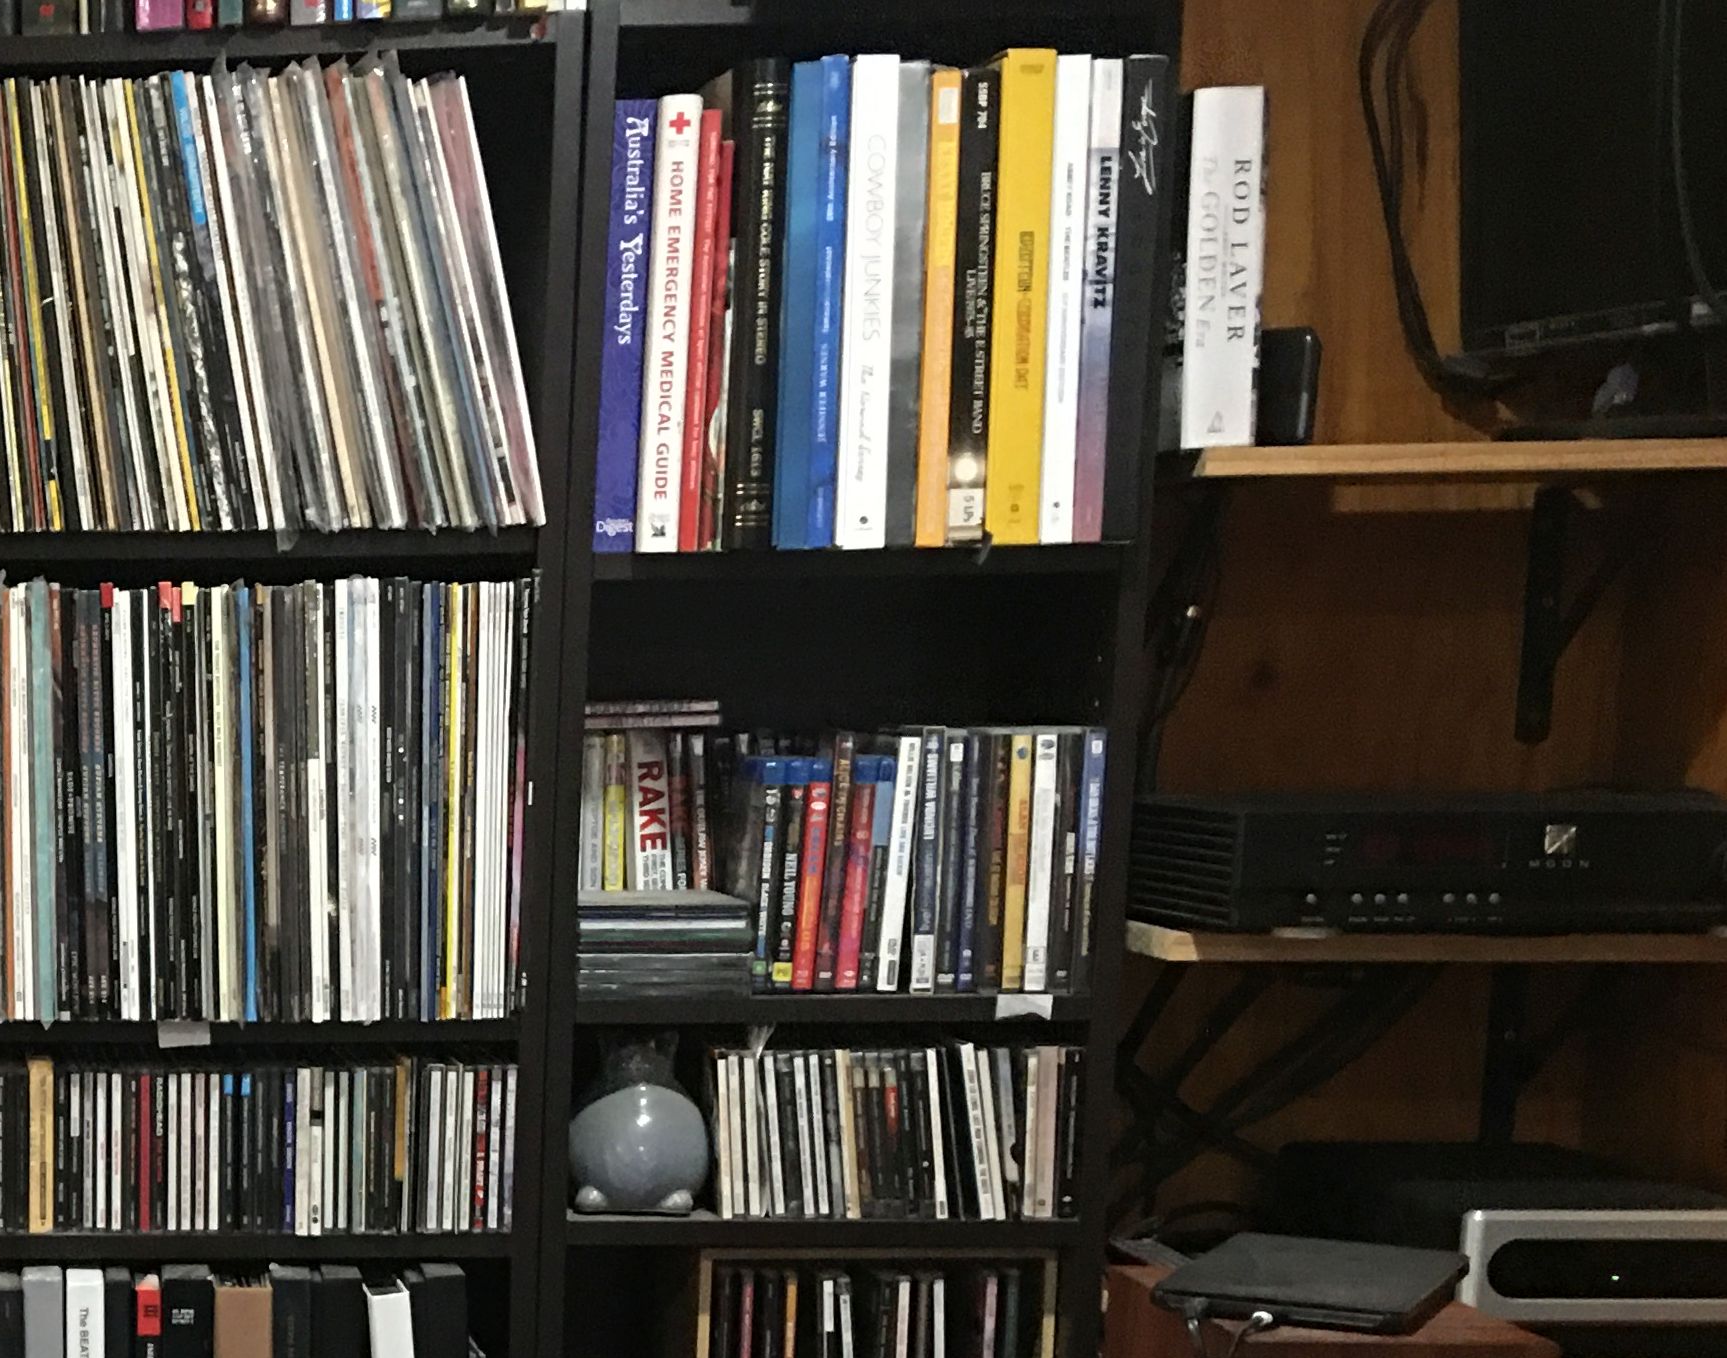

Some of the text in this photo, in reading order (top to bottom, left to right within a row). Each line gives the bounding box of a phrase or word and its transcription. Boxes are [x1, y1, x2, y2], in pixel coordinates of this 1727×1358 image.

[865, 135, 887, 248] COWBOY
[978, 172, 991, 212] BRUCE
[615, 117, 649, 345] Australia's Yesterdays
[976, 213, 990, 296] SPRINGSTEEN
[1092, 156, 1113, 309] LENNY KRAVITZ
[1197, 191, 1220, 313] GOLDEN
[1227, 159, 1253, 343] ROD LAVER
[757, 259, 771, 298] STORY
[861, 255, 883, 342] JUNKIES
[653, 160, 684, 500] HOME EMERGENCY MEDICAL GUIDE
[975, 313, 988, 337] THE
[973, 350, 986, 395] STREET
[972, 399, 984, 433] BAND
[638, 760, 668, 852] RAKE
[837, 759, 851, 790] ALICE
[924, 753, 939, 798] WILLIAMS
[923, 801, 936, 840] LUCINDA
[782, 853, 797, 916] NEIL YOUNG
[79, 1307, 90, 1327] The
